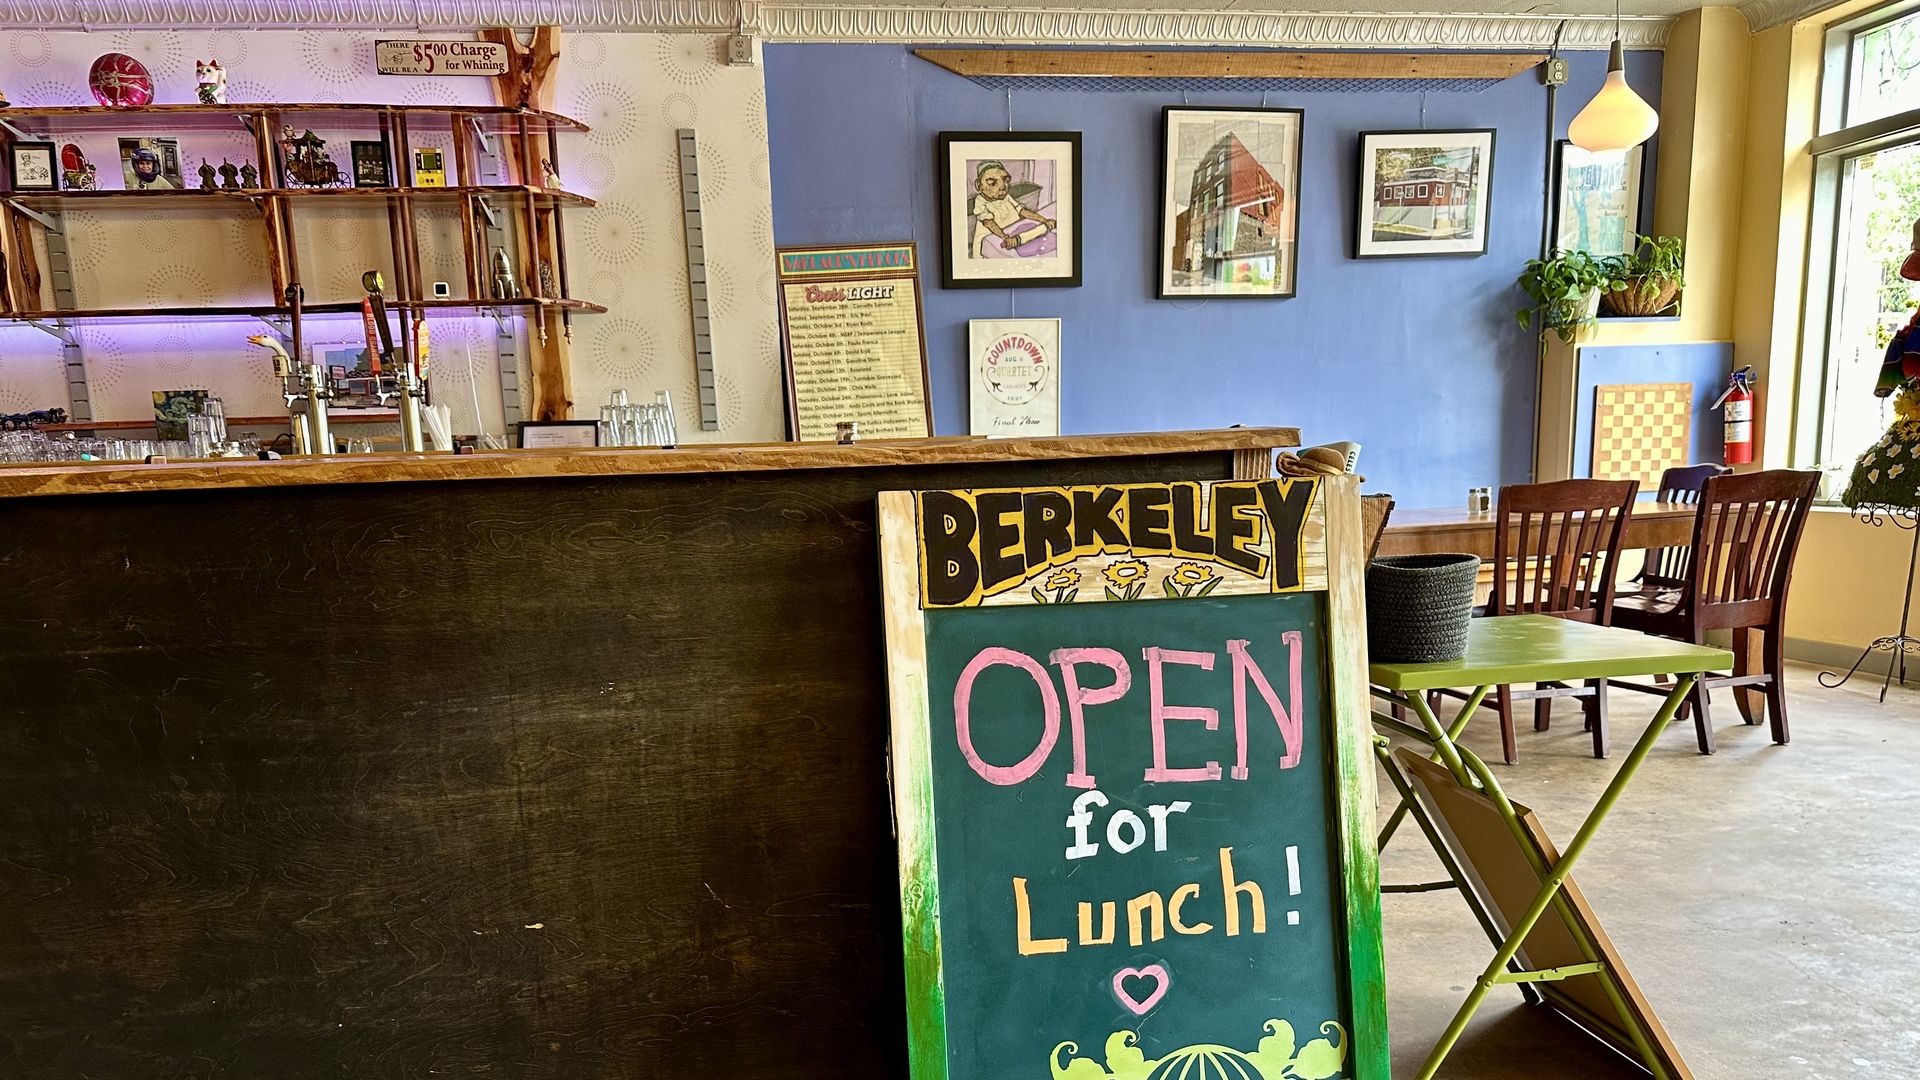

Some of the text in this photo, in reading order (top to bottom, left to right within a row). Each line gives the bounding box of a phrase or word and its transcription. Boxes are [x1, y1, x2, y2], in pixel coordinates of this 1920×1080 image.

[450, 42, 497, 60] Charge
[445, 60, 505, 73] for Whining
[804, 285, 894, 303] Coors LIGHT
[988, 336, 1044, 366] COUNTDOWN
[996, 366, 1032, 378] QUARTET
[992, 416, 1040, 426] Final Show
[1345, 451, 1356, 474] CELES
[922, 479, 1317, 606] BERKELEY
[953, 631, 1303, 789] OPEN
[1064, 790, 1192, 860] for
